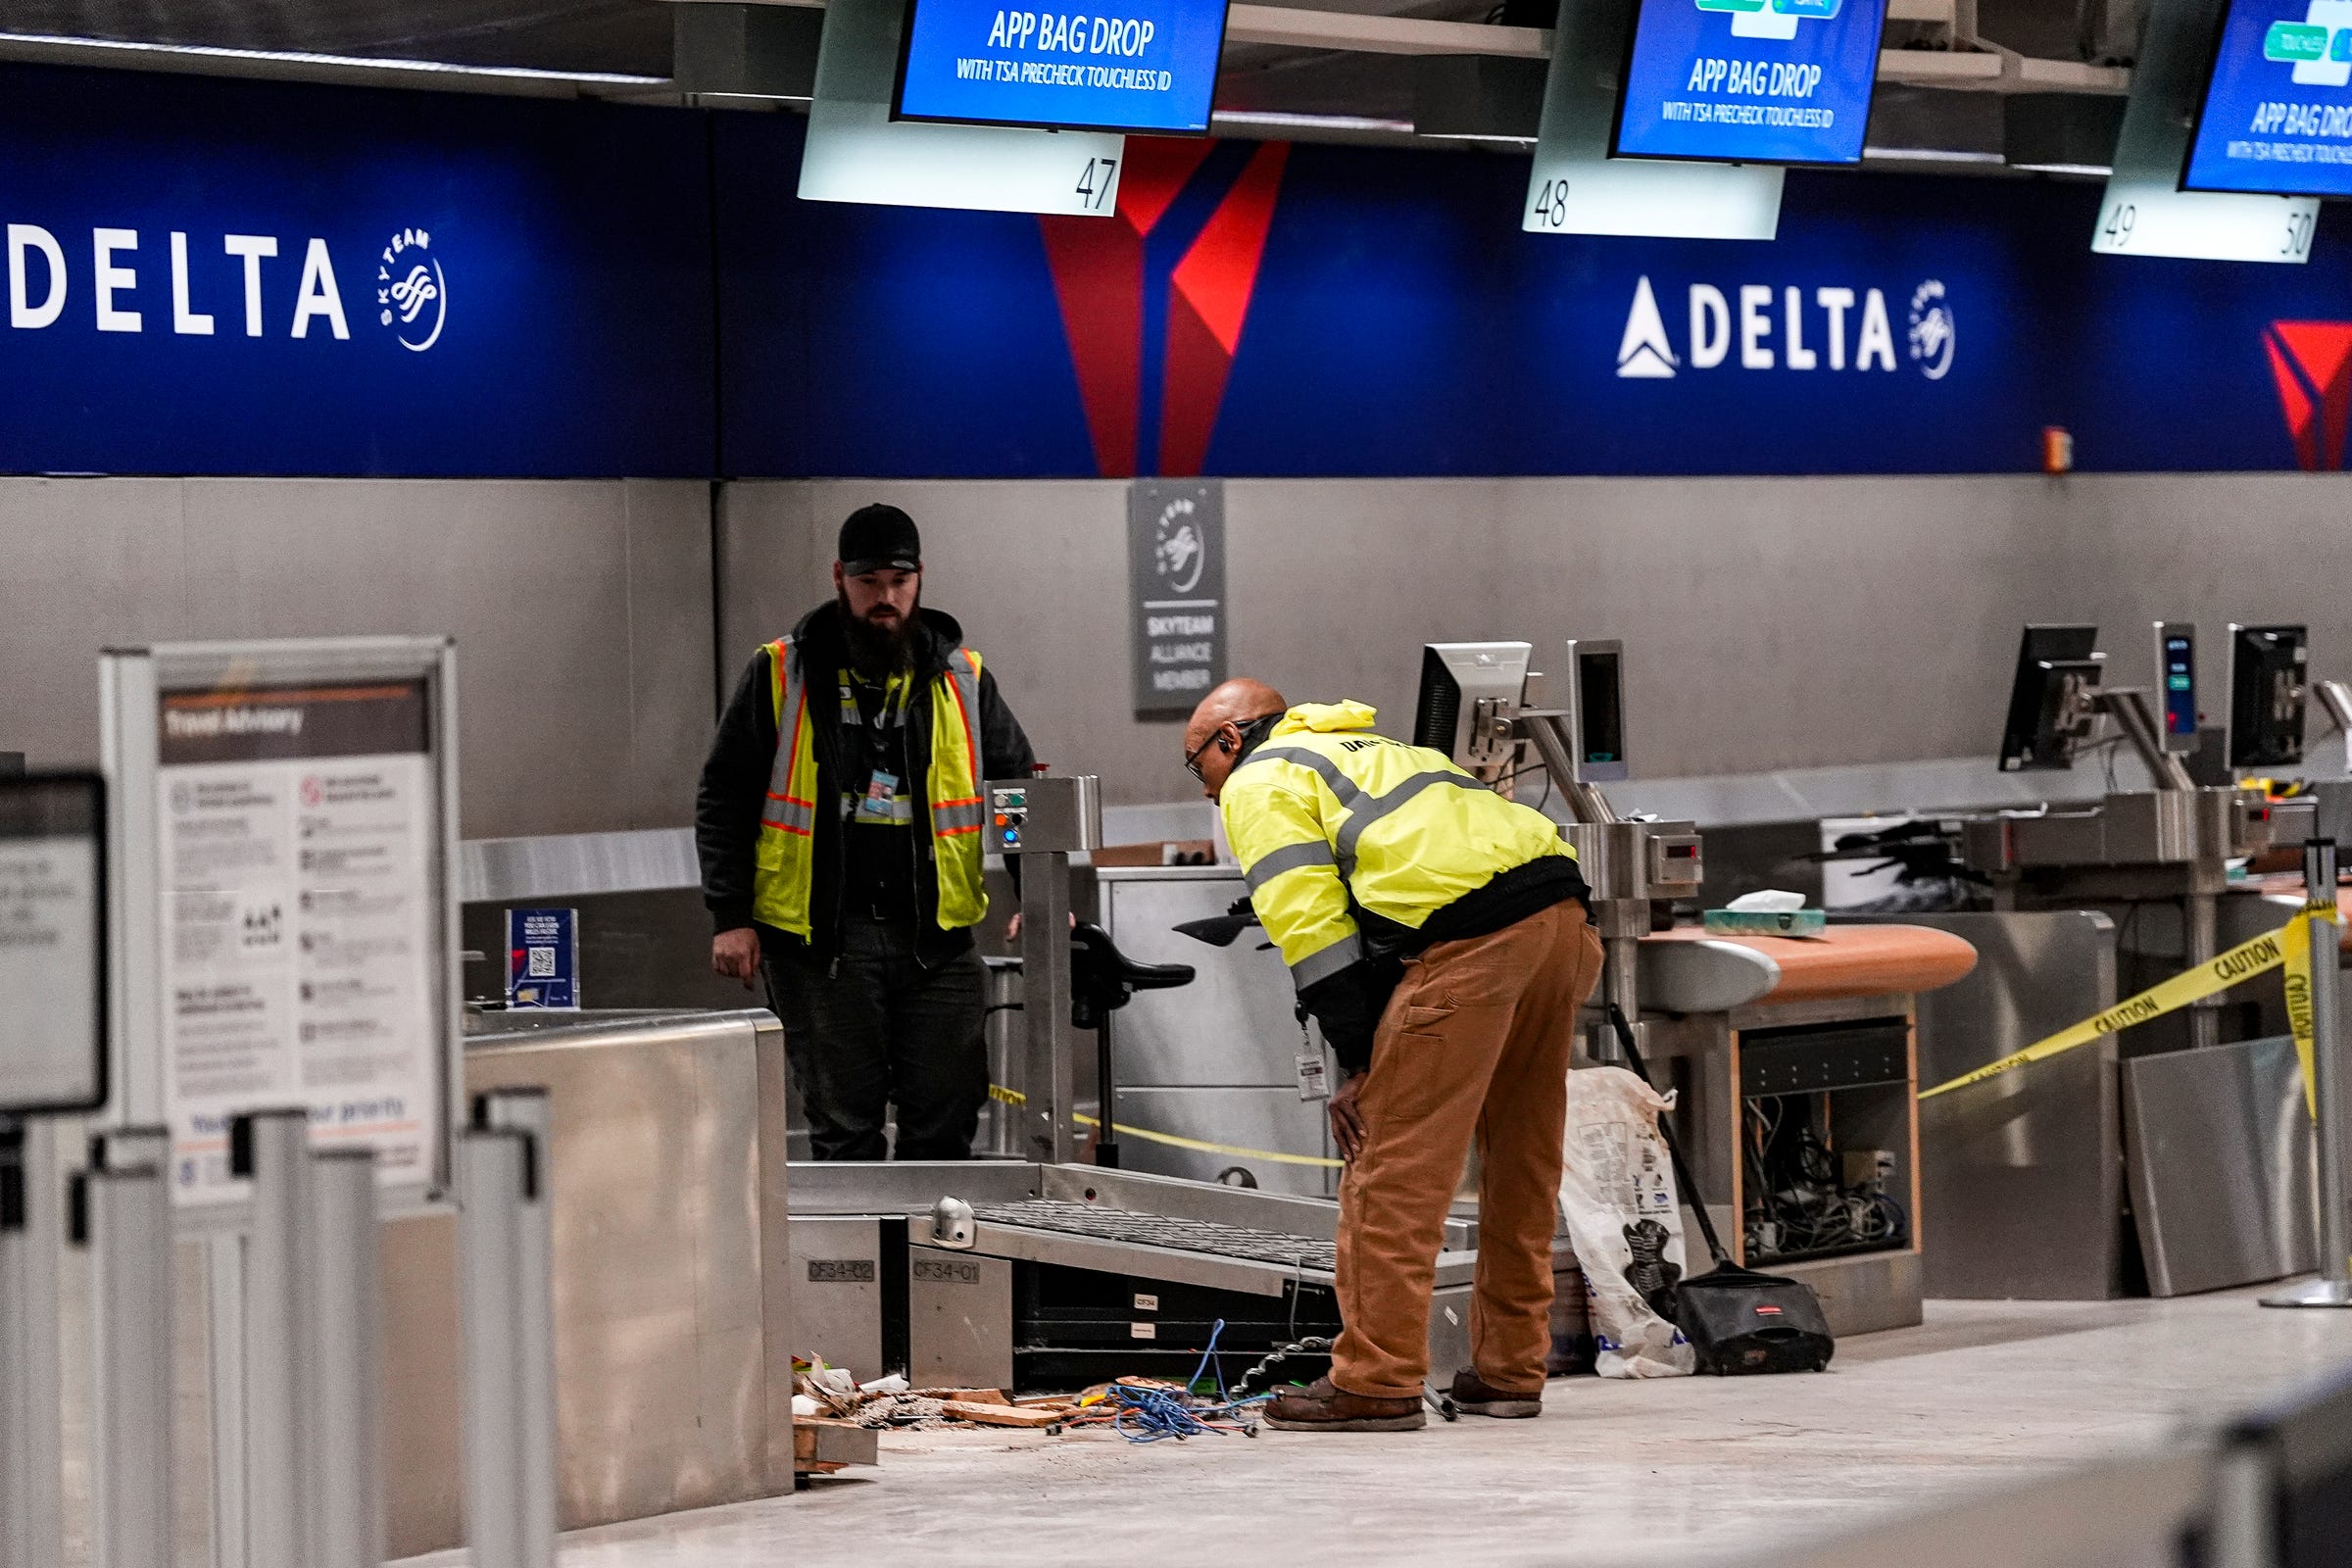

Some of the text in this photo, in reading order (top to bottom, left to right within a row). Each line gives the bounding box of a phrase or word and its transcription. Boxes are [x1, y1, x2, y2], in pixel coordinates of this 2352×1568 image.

[988, 11, 1154, 57] APP BAG DROP
[956, 58, 1172, 91] WITH TSA PRECHECK TOUCHLESS ID
[1687, 58, 1822, 98] APP BAG DROP
[1663, 101, 1835, 128] WITH TSA PRECHECK TOUCHLESS ID
[2250, 102, 2352, 138] APP BAG DRO
[1076, 158, 1117, 209] 47
[1535, 179, 1568, 227] 48
[2105, 203, 2135, 246] 49
[2281, 213, 2312, 254] 50
[7, 223, 351, 340] DELTA
[378, 227, 430, 326] SKYTEAM
[1689, 283, 1897, 371] DELTA
[1148, 615, 1214, 637] SKYTEAM
[2214, 937, 2281, 981] CAUTION
[2094, 995, 2160, 1036] CAUTION
[2287, 973, 2312, 1039] CAUTION
